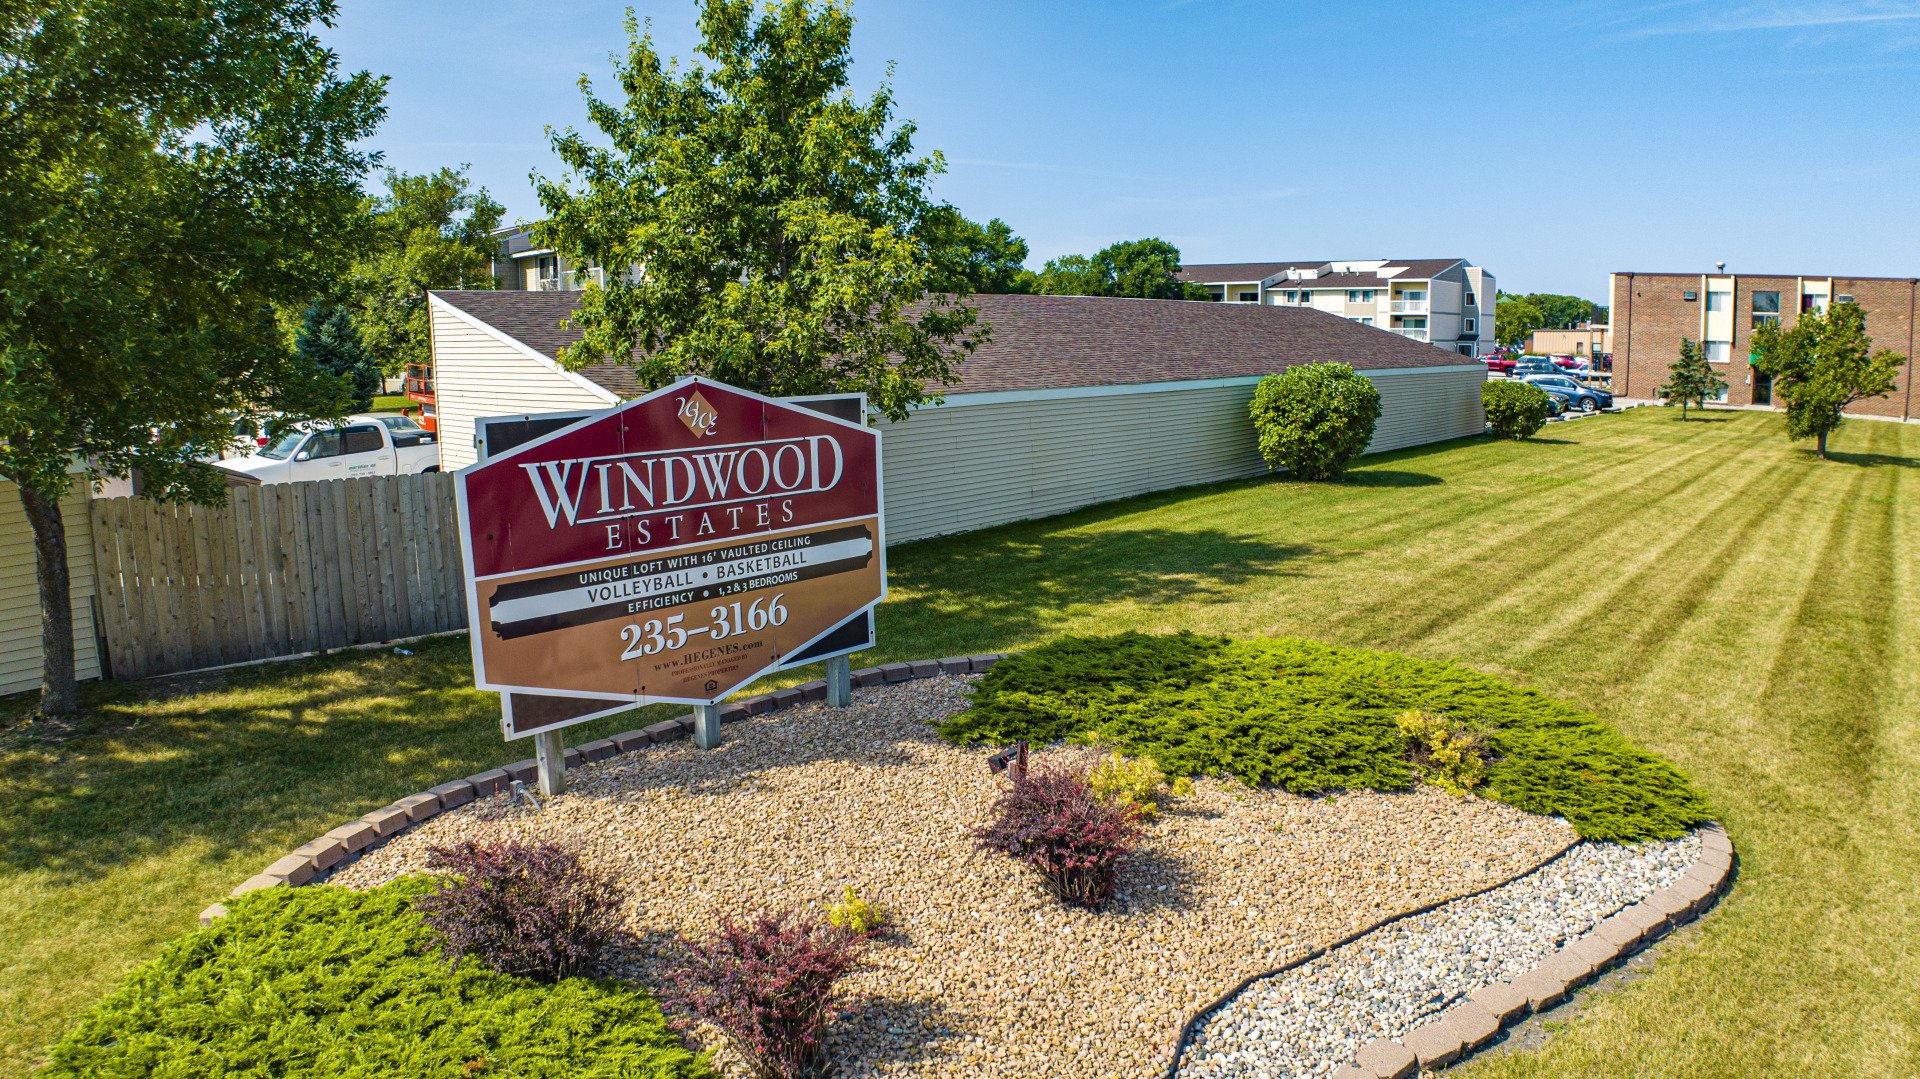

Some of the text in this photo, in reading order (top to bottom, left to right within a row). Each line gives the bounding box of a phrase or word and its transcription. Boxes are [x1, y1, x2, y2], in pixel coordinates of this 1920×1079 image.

[518, 434, 844, 530] WINDWOOD
[604, 499, 794, 550] ESTATES
[579, 566, 629, 584] UNIQUE
[633, 560, 663, 575] LOFT
[667, 554, 698, 569] WITH
[720, 543, 768, 560] VAULTED
[771, 536, 811, 551] CEILING
[587, 551, 807, 603] VOLLEYBALL BASKETBALL
[627, 591, 695, 614] EFFICIENCY
[726, 585, 732, 594] 2
[733, 583, 741, 592] &
[742, 581, 748, 592] 3
[749, 571, 798, 589] BEDROOMS
[653, 640, 764, 672] www.HEGENES.com
[671, 662, 715, 676] PROFESSIONALLY
[717, 655, 740, 666] MANAGED
[708, 665, 739, 677] PROPERTIES
